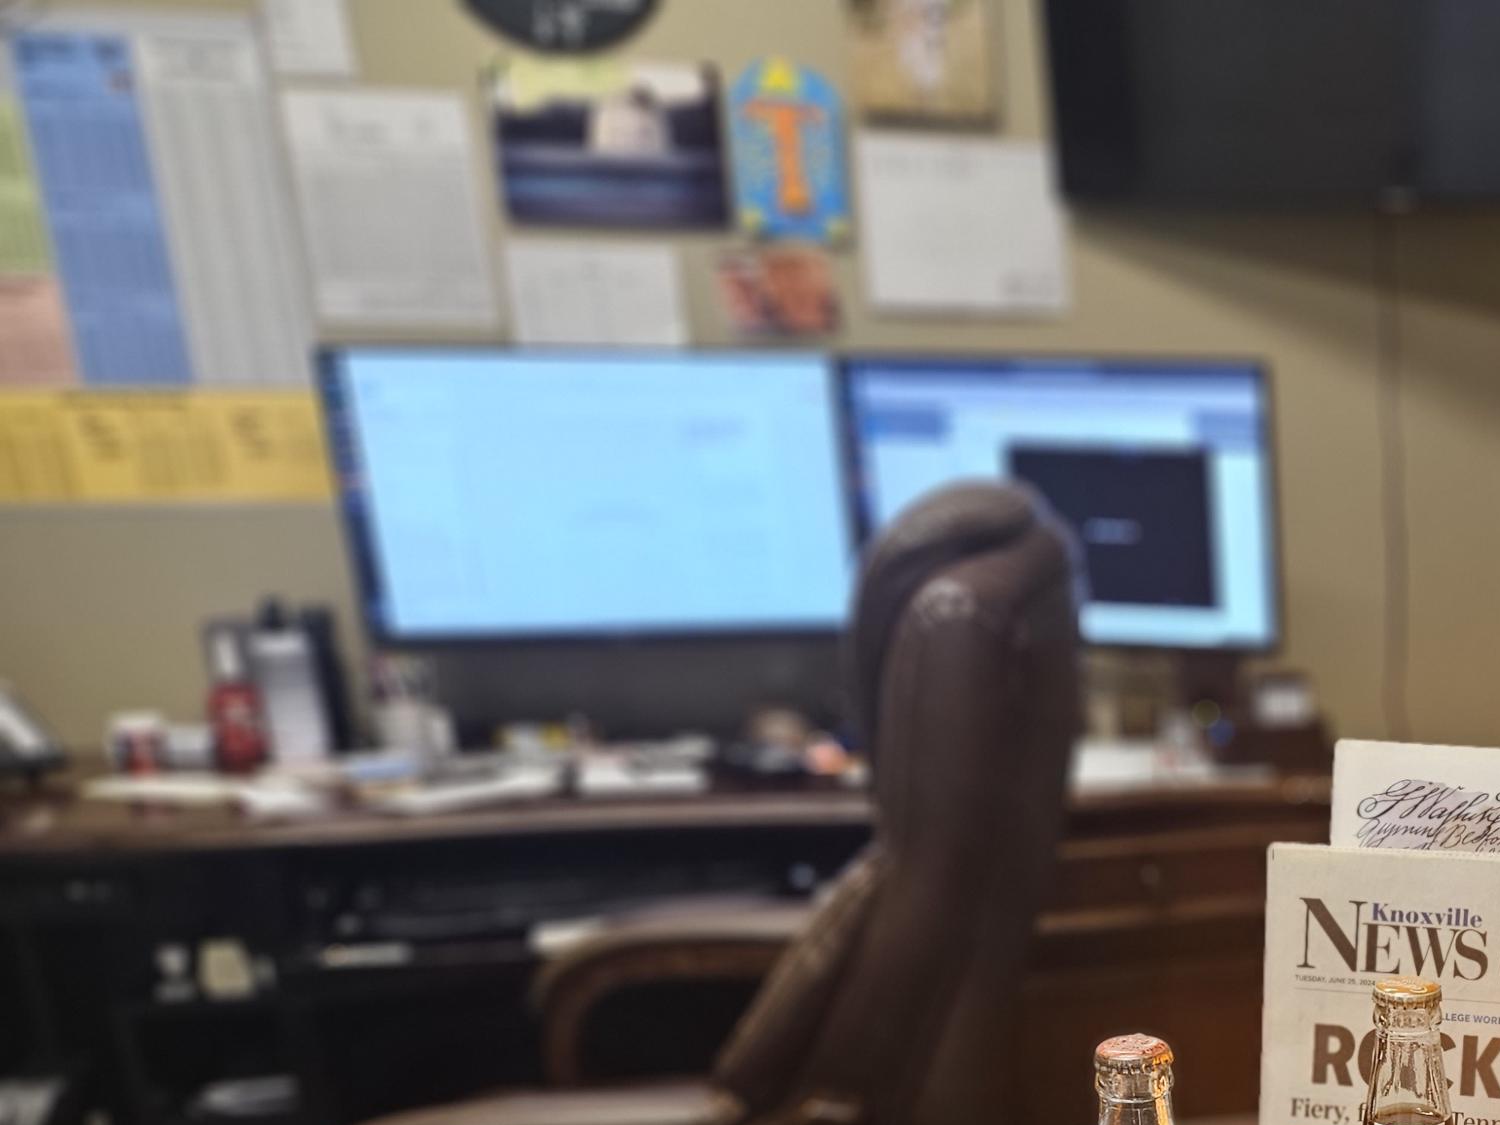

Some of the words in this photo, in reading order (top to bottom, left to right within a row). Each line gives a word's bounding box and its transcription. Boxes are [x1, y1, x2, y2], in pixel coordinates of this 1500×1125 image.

[1371, 902, 1483, 929] Knoxville
[1297, 898, 1488, 981] NEWS
[1295, 974, 1327, 984] TUESDAY,
[1329, 977, 1347, 985] JUNE
[1360, 979, 1376, 987] 2024
[1290, 1097, 1350, 1125] Fiery,
